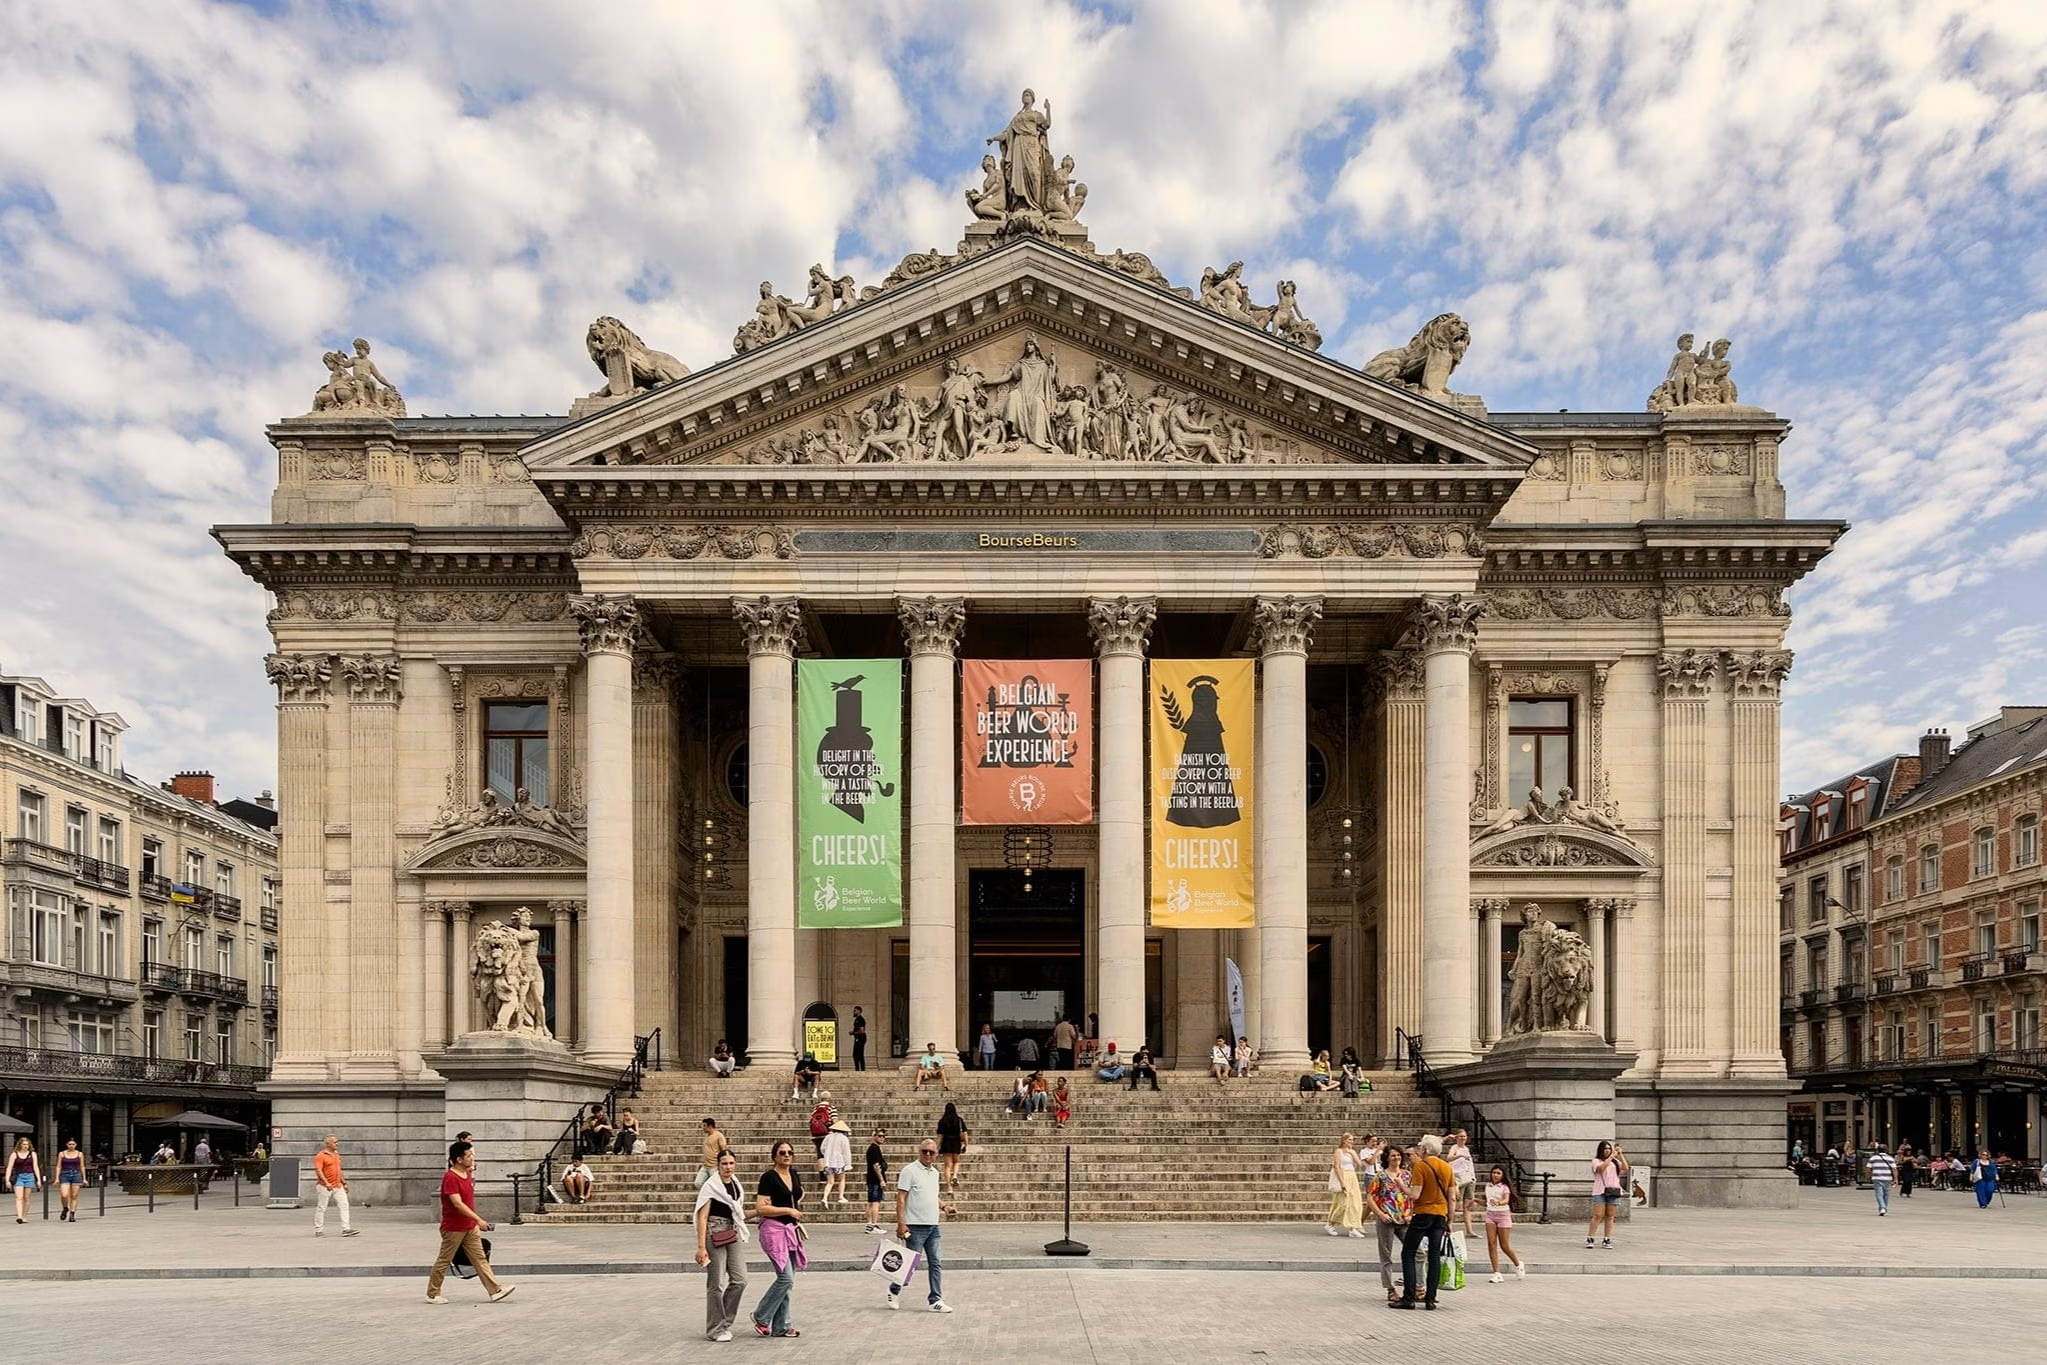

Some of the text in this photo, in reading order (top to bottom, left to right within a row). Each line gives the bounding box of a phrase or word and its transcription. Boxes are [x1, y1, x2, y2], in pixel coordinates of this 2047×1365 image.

[979, 533, 1078, 546] BourseBeurs
[977, 710, 1077, 734] BEER WORLD
[862, 750, 876, 762] THE
[1205, 753, 1230, 766] YOUR
[850, 763, 866, 776] OF
[867, 764, 884, 776] BEER
[1207, 767, 1223, 780] OF
[1224, 768, 1241, 780] BEER
[841, 778, 847, 791] A
[1227, 782, 1234, 794] A
[831, 792, 844, 804] THE
[845, 792, 876, 804] BEERLAB
[1199, 796, 1212, 809] THE
[1213, 796, 1244, 809] BEERLAB
[812, 834, 886, 866] CHEERS!
[1165, 838, 1239, 869] CHEERS!
[842, 887, 873, 898] Belgian
[1194, 890, 1226, 900] Belgian
[842, 896, 886, 904] Beer World
[1194, 898, 1239, 907] Beer World
